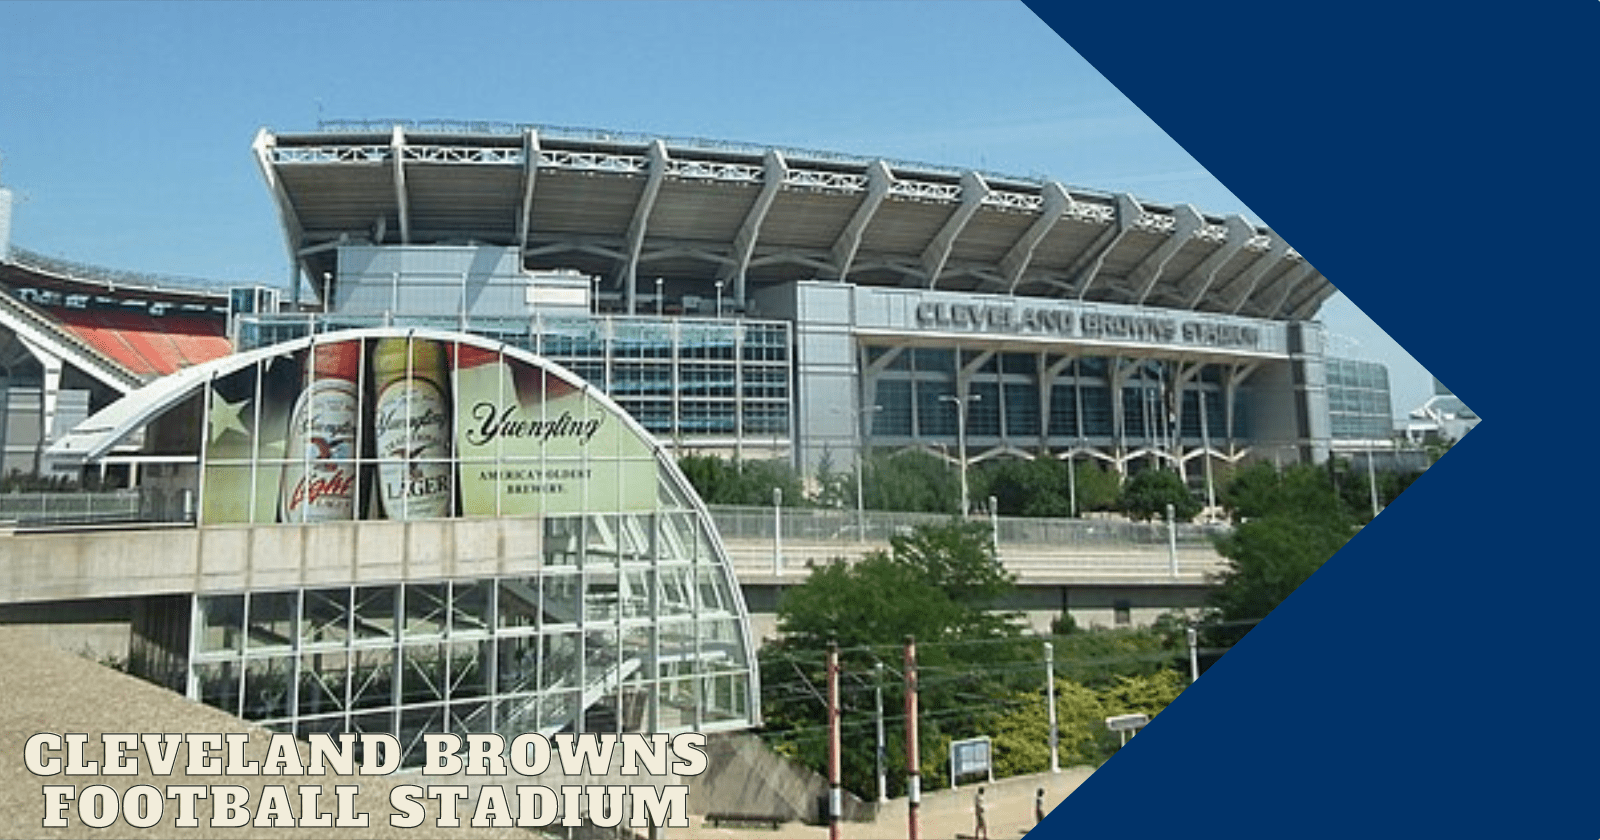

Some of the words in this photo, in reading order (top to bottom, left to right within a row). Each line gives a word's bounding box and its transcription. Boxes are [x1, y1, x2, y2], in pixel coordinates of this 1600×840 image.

[915, 300, 1076, 335] CLEVELAND
[1080, 312, 1176, 342] BROWNS
[465, 402, 606, 446] Yuengling
